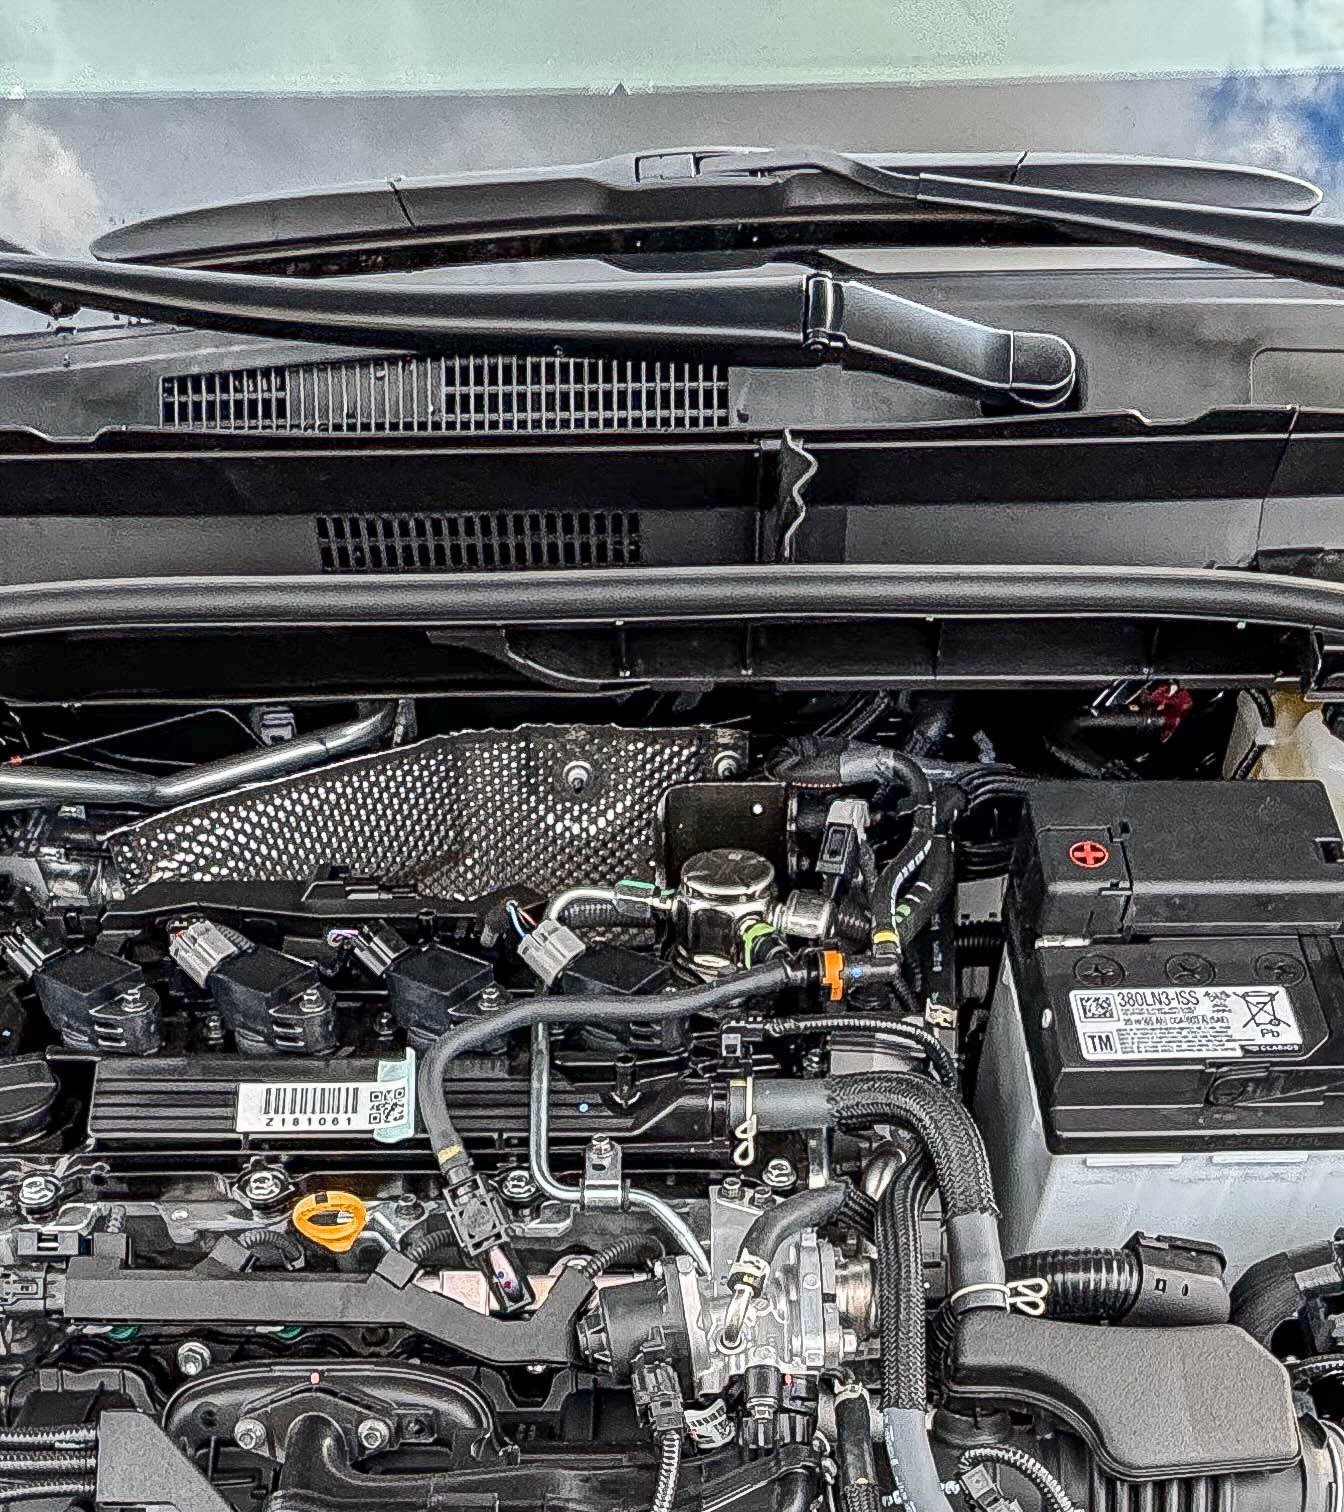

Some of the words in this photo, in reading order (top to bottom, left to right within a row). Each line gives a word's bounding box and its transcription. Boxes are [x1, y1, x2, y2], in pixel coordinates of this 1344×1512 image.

[1117, 990, 1200, 1008] 380LN3-ISS
[1260, 1028, 1281, 1038] Pb
[1088, 1034, 1113, 1052] TM
